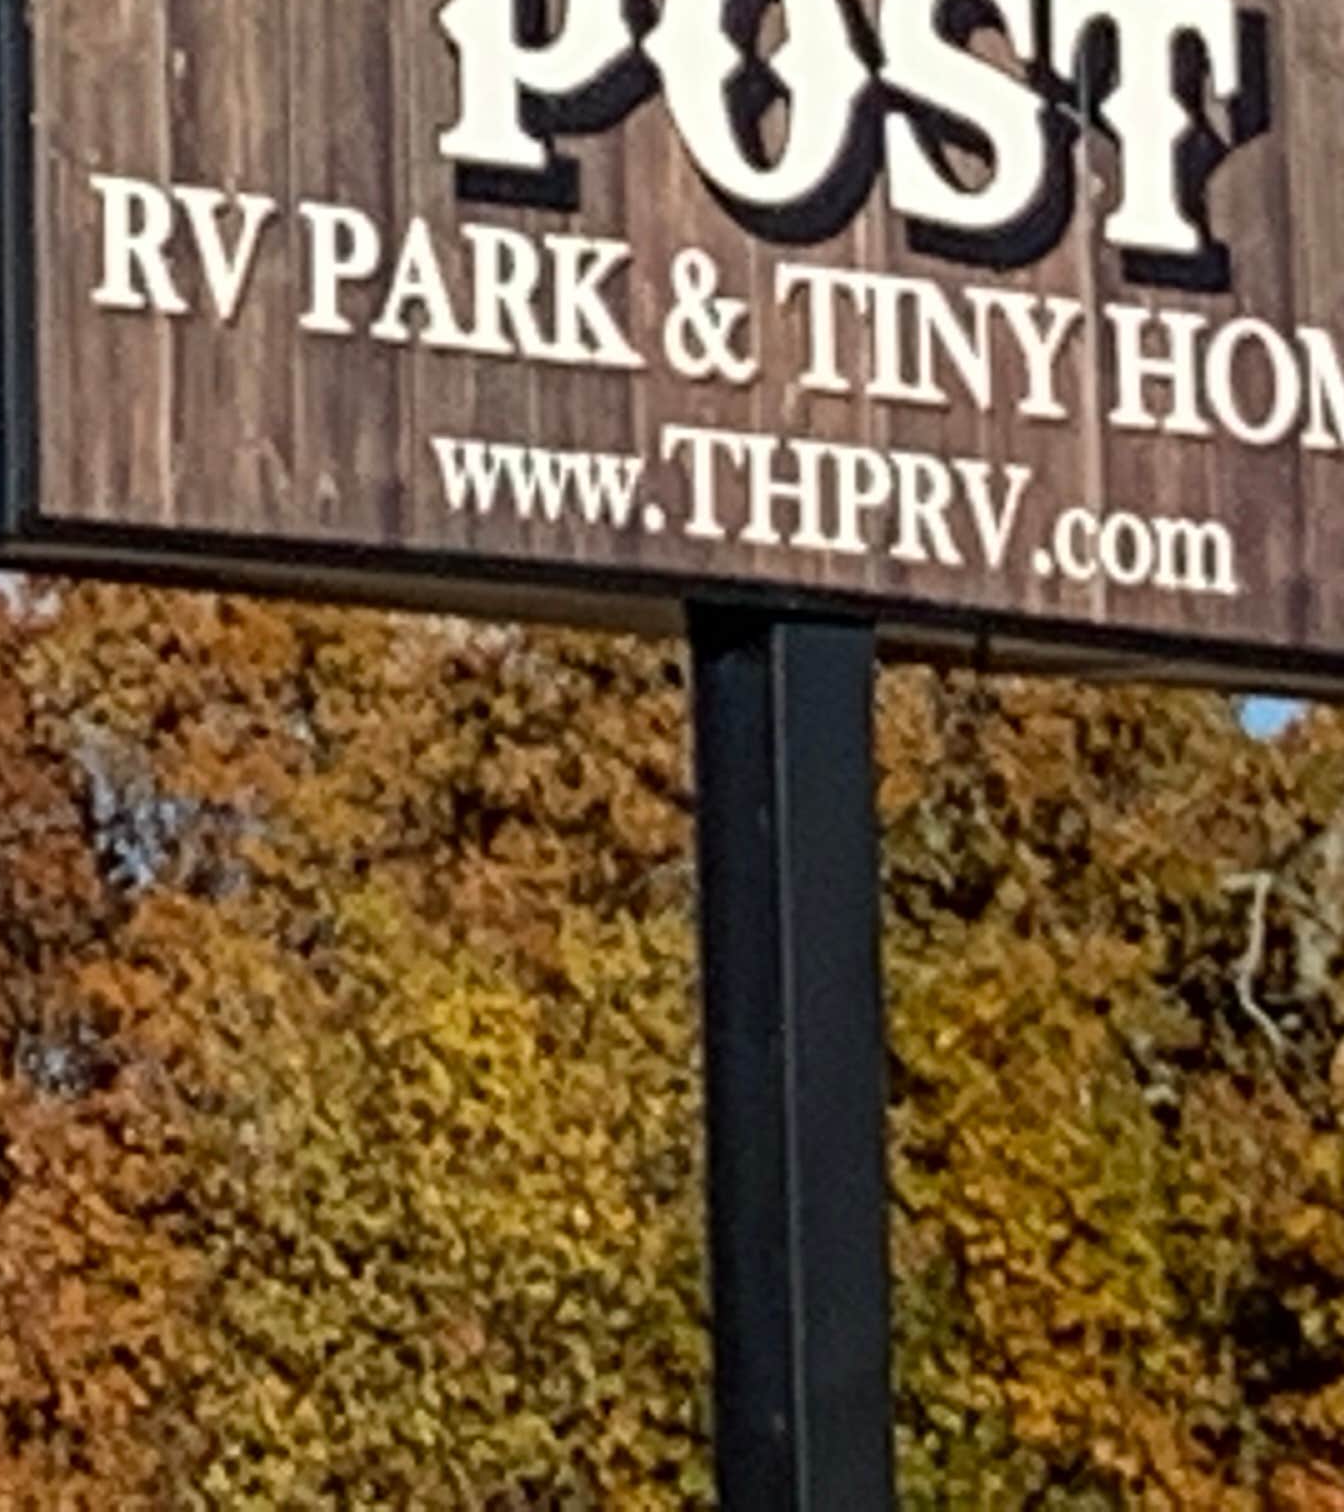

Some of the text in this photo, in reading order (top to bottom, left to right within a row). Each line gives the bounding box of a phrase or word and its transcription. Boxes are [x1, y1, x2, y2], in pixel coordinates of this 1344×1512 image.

[88, 173, 276, 322] RV
[298, 199, 646, 369] PARK
[663, 246, 759, 384] &
[775, 261, 1084, 420] TINY
[430, 422, 1240, 596] www.THPRV.com
